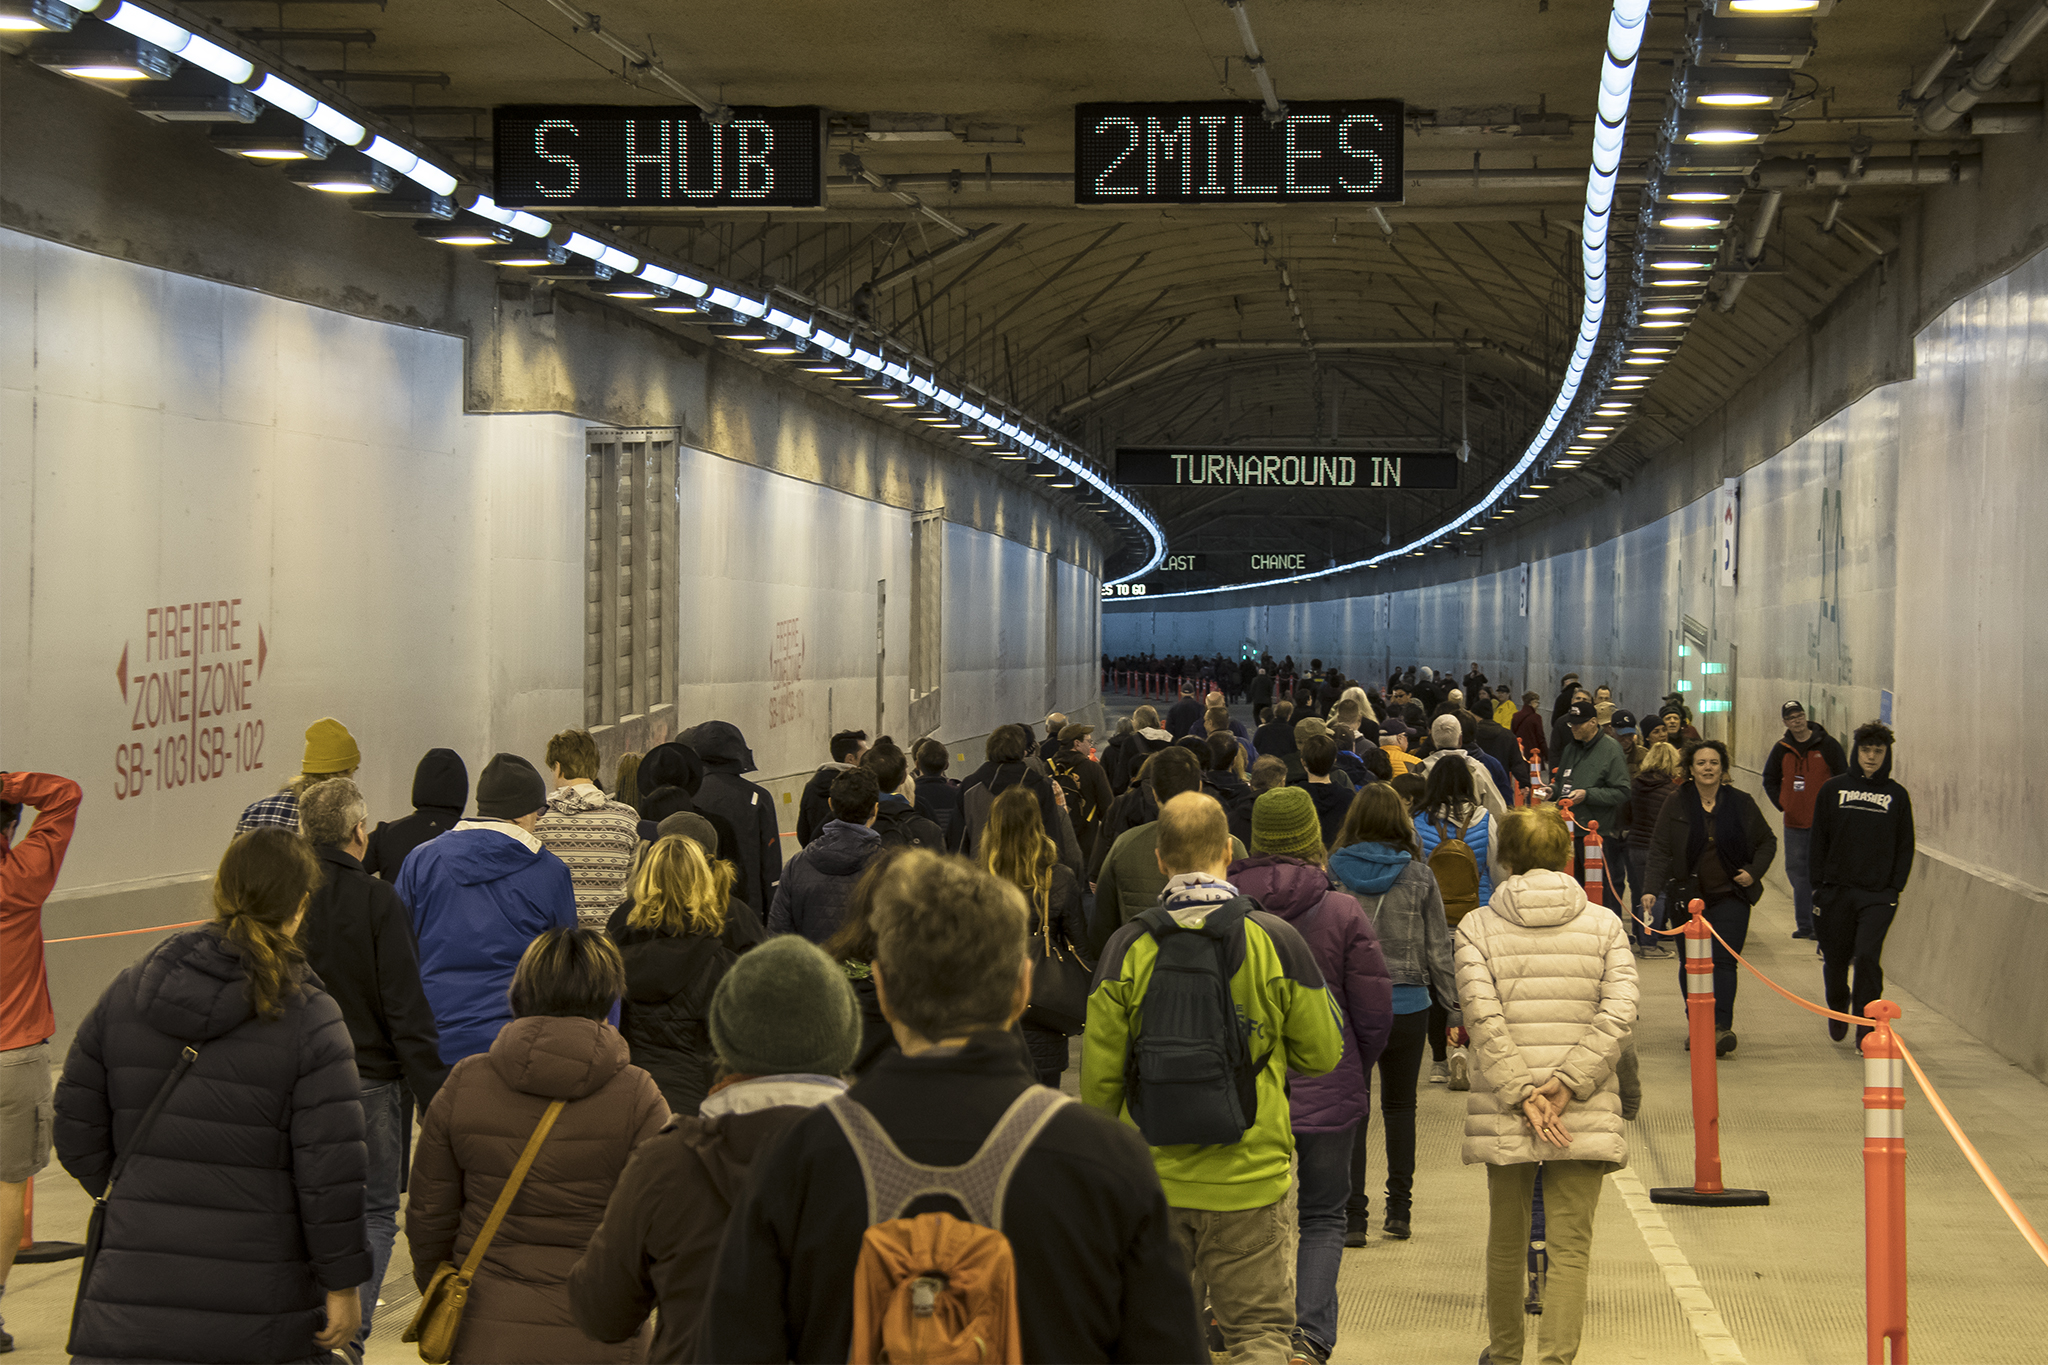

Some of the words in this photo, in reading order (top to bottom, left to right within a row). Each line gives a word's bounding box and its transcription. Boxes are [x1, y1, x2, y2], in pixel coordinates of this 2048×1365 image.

[535, 119, 580, 198] S
[625, 119, 775, 198] HUB
[1170, 454, 1356, 486] TURNAROUND
[1371, 456, 1401, 487] IN
[1116, 584, 1130, 596] TO
[1160, 555, 1196, 571] LAST
[1251, 554, 1306, 570] CHANCE
[147, 604, 191, 662] FIRE
[200, 599, 241, 654] FIRE
[132, 668, 190, 731] ZONE
[199, 659, 252, 718] ZONE
[114, 733, 189, 801] SB-103
[197, 718, 265, 783] SB-102
[1838, 790, 1893, 812] THRASHER
